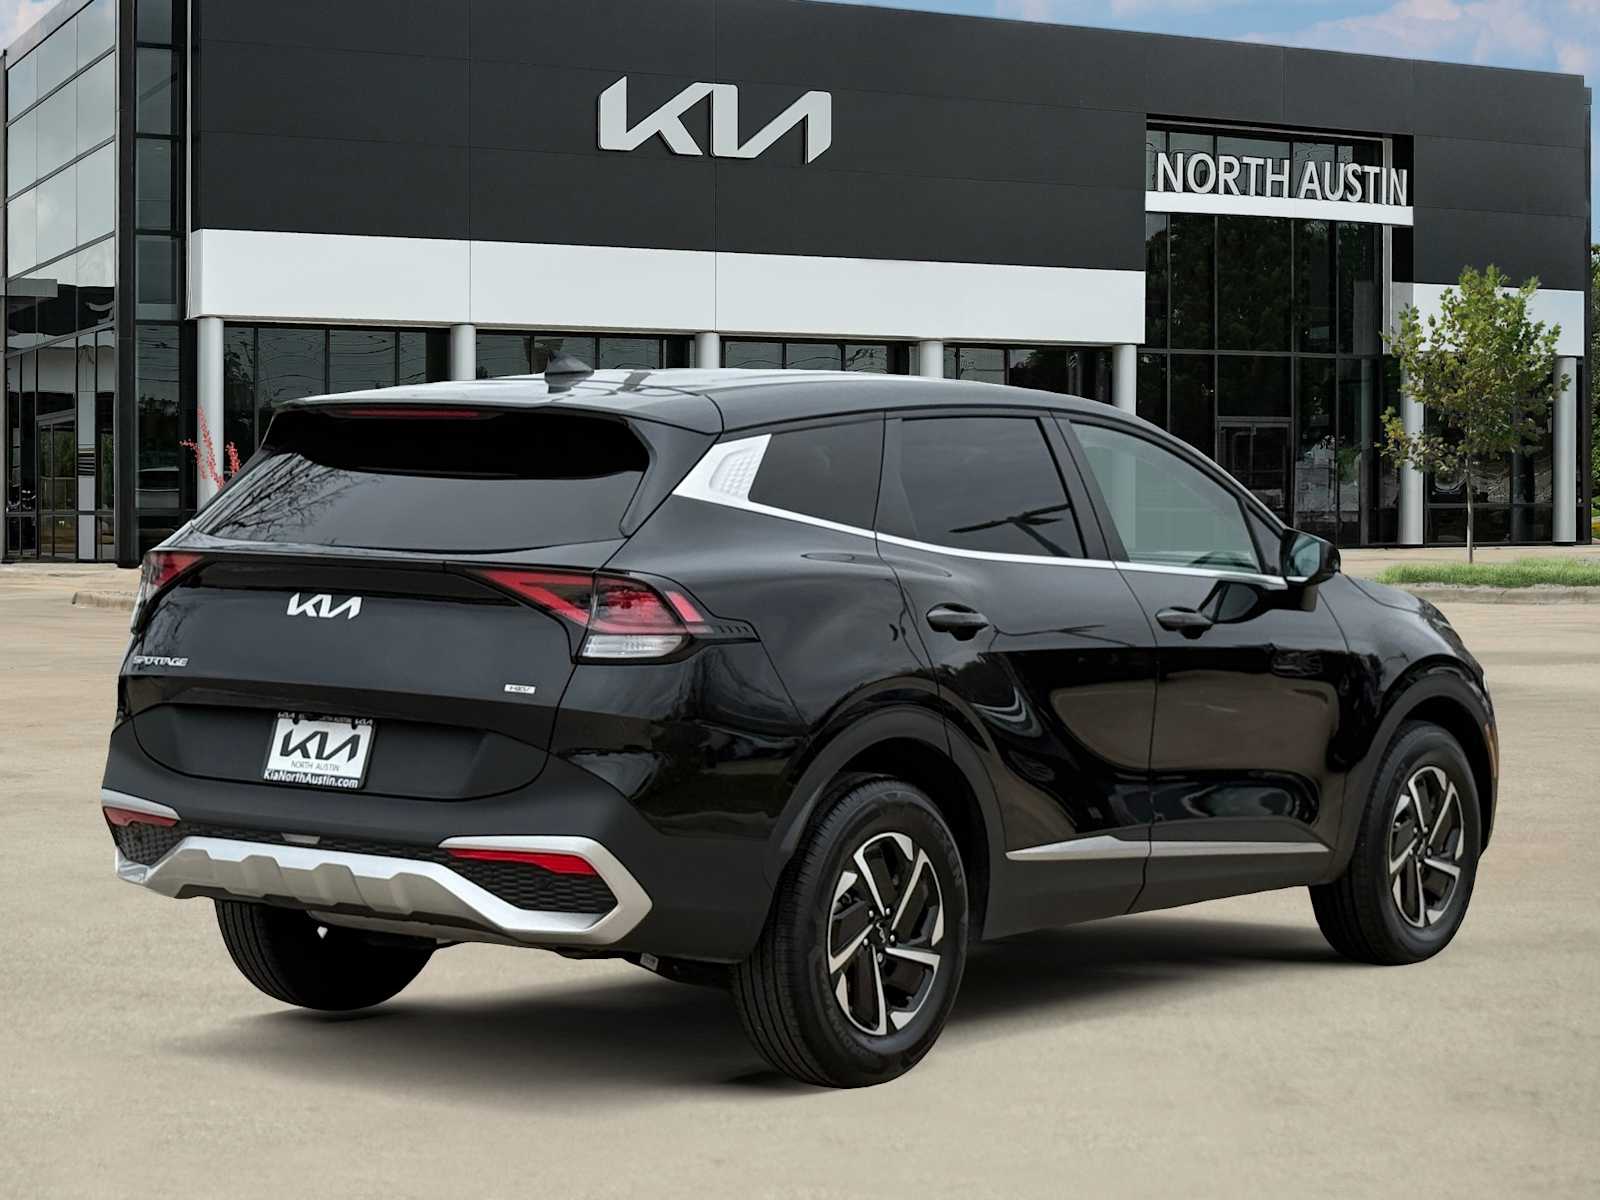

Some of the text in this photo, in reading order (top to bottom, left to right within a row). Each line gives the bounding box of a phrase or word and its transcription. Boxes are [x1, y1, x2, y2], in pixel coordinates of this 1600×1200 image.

[598, 76, 832, 164] KIA
[1157, 152, 1407, 206] NORTH AUSTIN
[286, 592, 362, 619] KIA
[132, 655, 189, 667] SPORTAGE
[279, 729, 361, 762] KIA
[263, 769, 359, 788] KiaNorthAustin.com
[291, 760, 340, 772] NORTH AUSTIN
